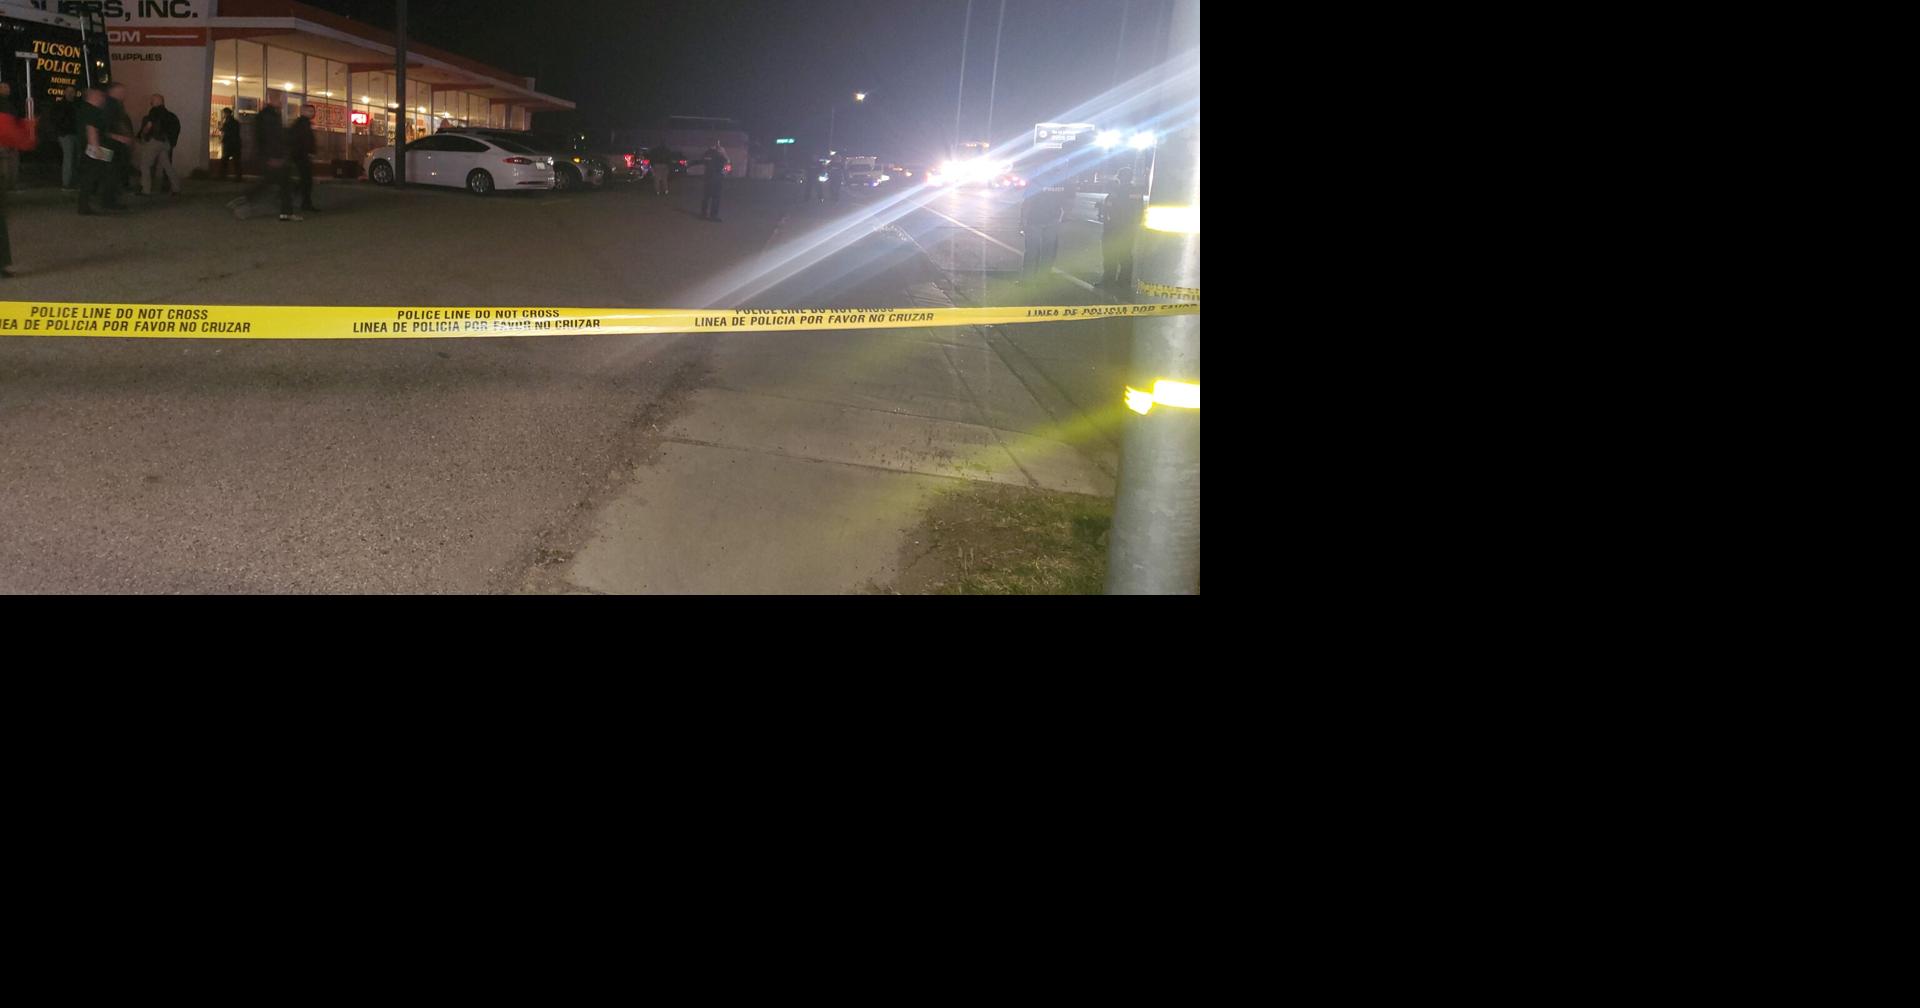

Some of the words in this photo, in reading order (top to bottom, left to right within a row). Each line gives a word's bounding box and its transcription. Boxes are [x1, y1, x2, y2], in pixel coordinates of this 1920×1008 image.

[138, 0, 198, 18] INC.
[107, 30, 140, 43] OM
[32, 40, 81, 58] TUCSON
[111, 53, 162, 61] SUPPLIES
[36, 57, 81, 75] POLICE
[30, 306, 79, 318] POLICE
[82, 307, 112, 319] LINE
[116, 308, 133, 319] DO
[138, 308, 163, 319] NOT
[167, 309, 208, 320] CROSS
[397, 310, 441, 320] POLICE
[444, 310, 471, 319] LINE
[475, 310, 490, 319] DO
[495, 310, 517, 319] NOT
[522, 309, 560, 318] CROSS
[695, 317, 727, 327] LINEA
[732, 316, 745, 326] DE
[750, 316, 796, 326] POLICIA
[800, 315, 823, 325] POR
[828, 314, 865, 324] FAVOR
[869, 314, 885, 323] NO
[889, 313, 934, 322] CRUZAR
[24, 319, 40, 330] DE
[46, 320, 97, 331] POLICIA
[102, 320, 128, 331] POR
[134, 321, 175, 332] FAVOR
[179, 321, 197, 332] NO
[201, 322, 251, 333] CRUZAR
[353, 322, 388, 333] LINEA
[393, 321, 407, 332] DE
[413, 321, 460, 332] POLICIA
[535, 319, 550, 330] NO
[555, 319, 601, 330] CRUZAR
